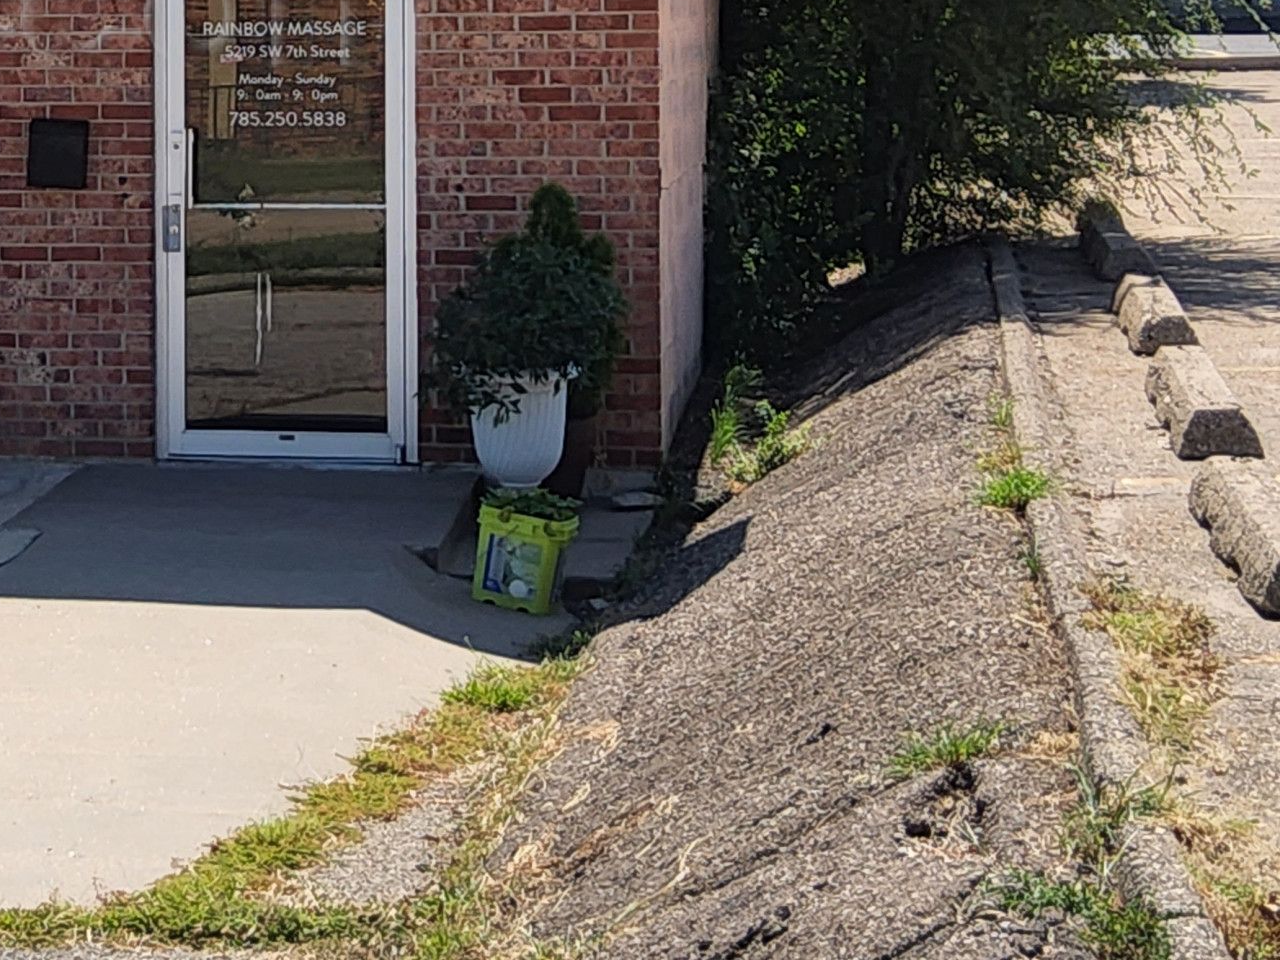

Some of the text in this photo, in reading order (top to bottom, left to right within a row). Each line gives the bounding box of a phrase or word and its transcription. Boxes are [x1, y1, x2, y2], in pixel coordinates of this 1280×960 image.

[203, 20, 367, 37] RAINBOW MASSAGE
[225, 44, 351, 58] 5219 SW 7th Street
[239, 72, 284, 88] Monday
[295, 72, 336, 88] Sunday
[229, 111, 346, 127] 785.250.5838
